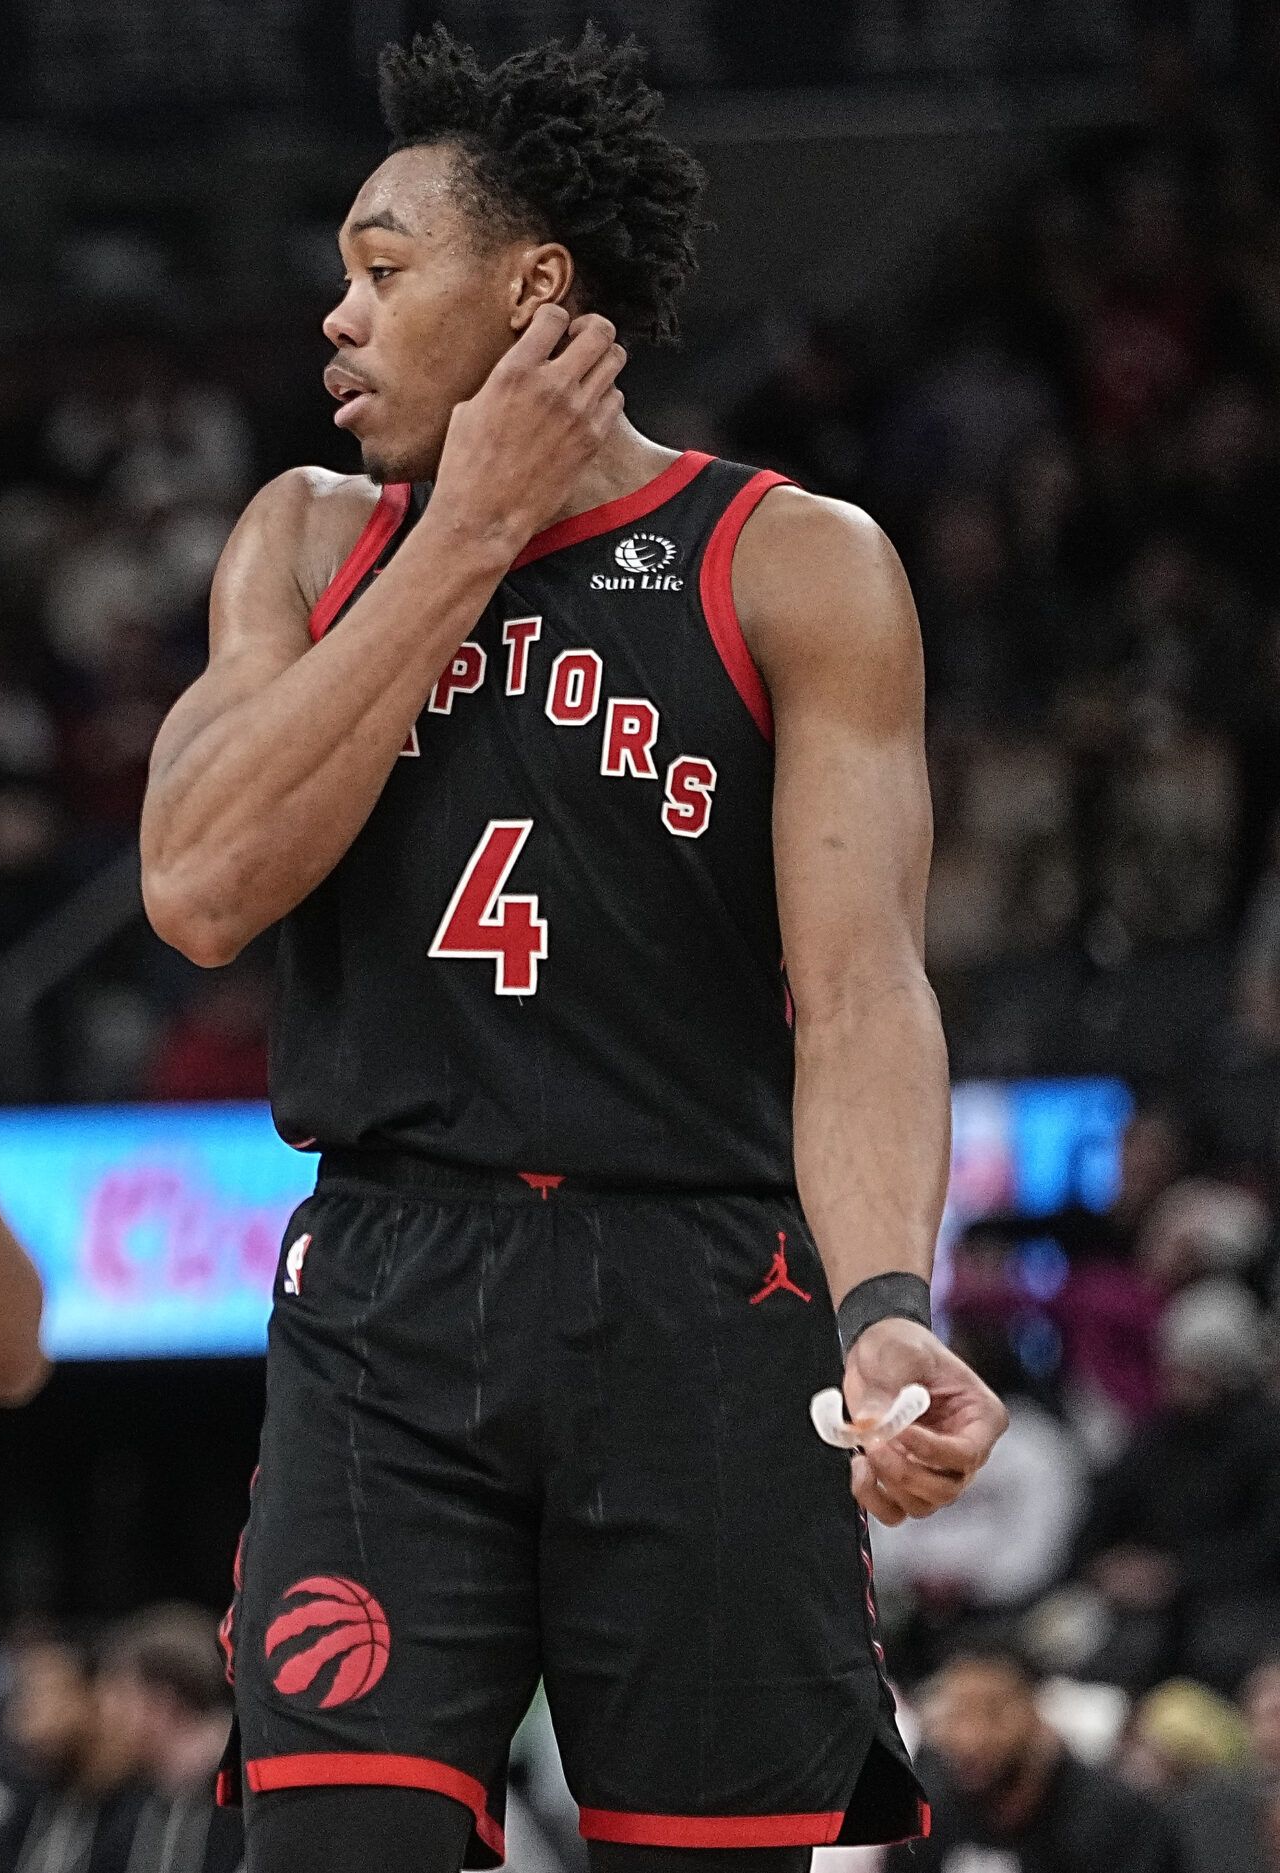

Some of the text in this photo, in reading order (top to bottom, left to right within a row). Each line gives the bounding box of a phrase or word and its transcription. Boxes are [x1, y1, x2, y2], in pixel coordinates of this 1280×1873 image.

[589, 573, 684, 591] Sun Life
[399, 616, 717, 838] PTORS
[427, 818, 548, 996] 4
